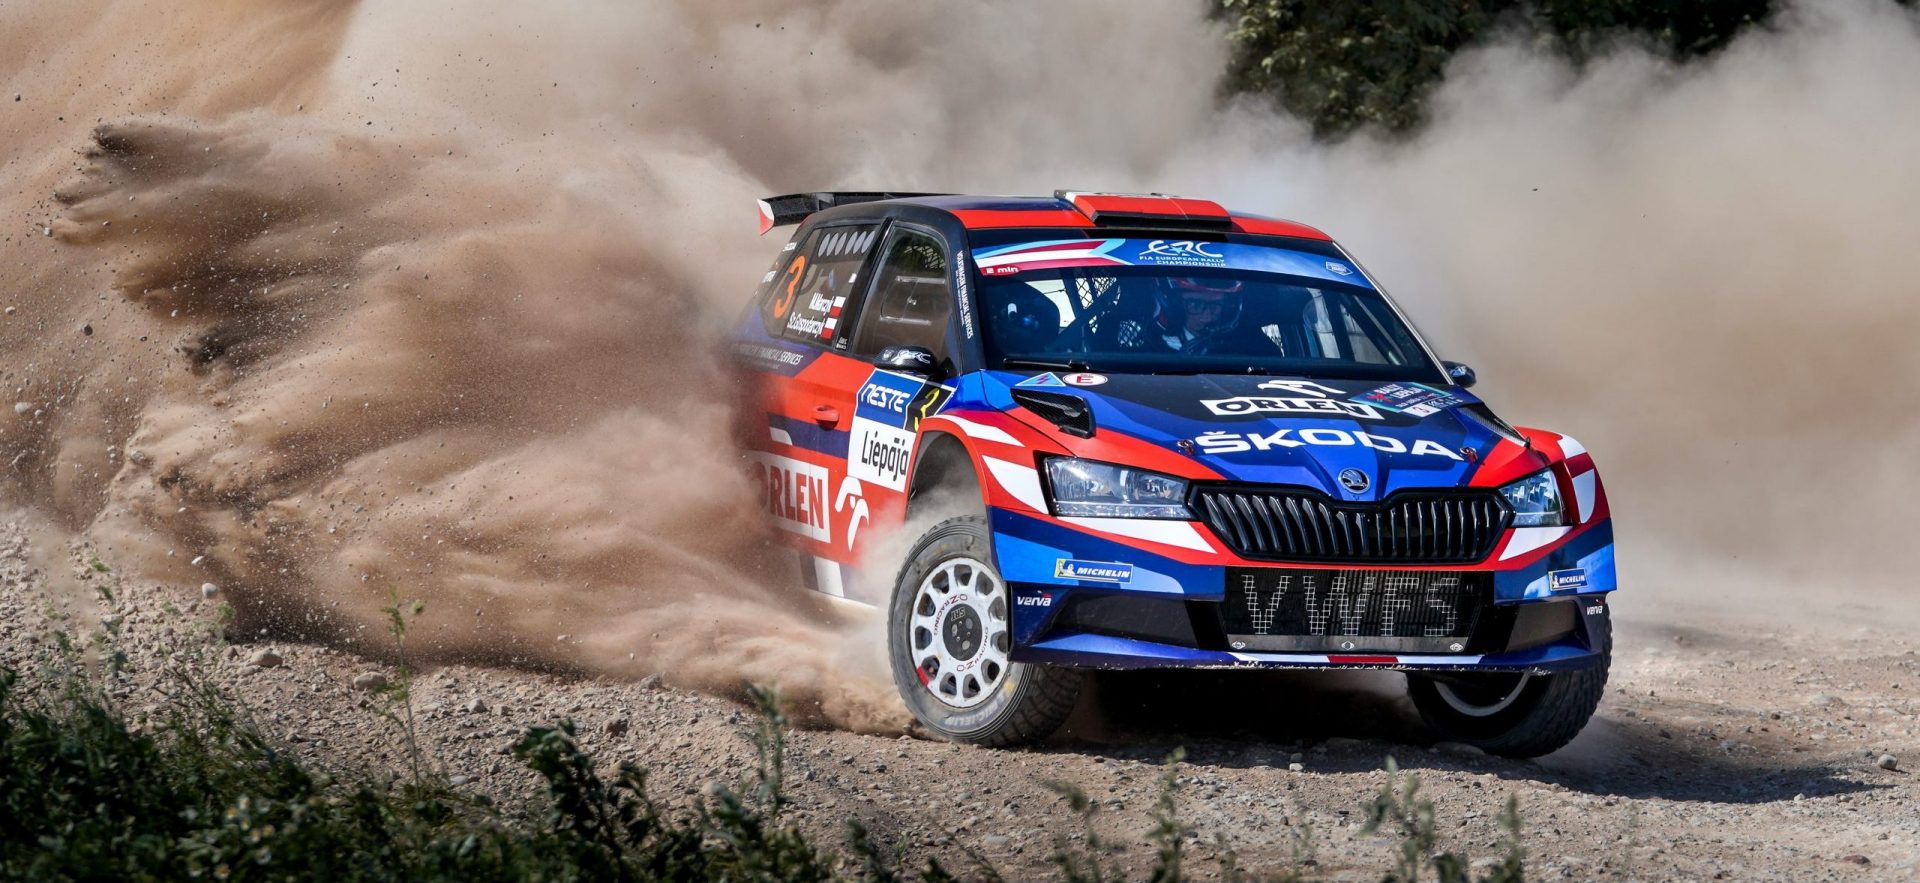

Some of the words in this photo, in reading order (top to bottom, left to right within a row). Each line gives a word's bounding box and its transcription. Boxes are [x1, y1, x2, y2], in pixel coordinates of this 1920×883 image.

[774, 256, 806, 319] 3
[1216, 400, 1371, 417] ORLEN
[861, 430, 909, 482] Liepāja
[1195, 429, 1465, 461] ŠKODA
[750, 461, 824, 529] ORLEN
[1077, 567, 1131, 578] MICHELIN
[1559, 574, 1586, 585] MICHELIN
[1017, 596, 1052, 607] verva
